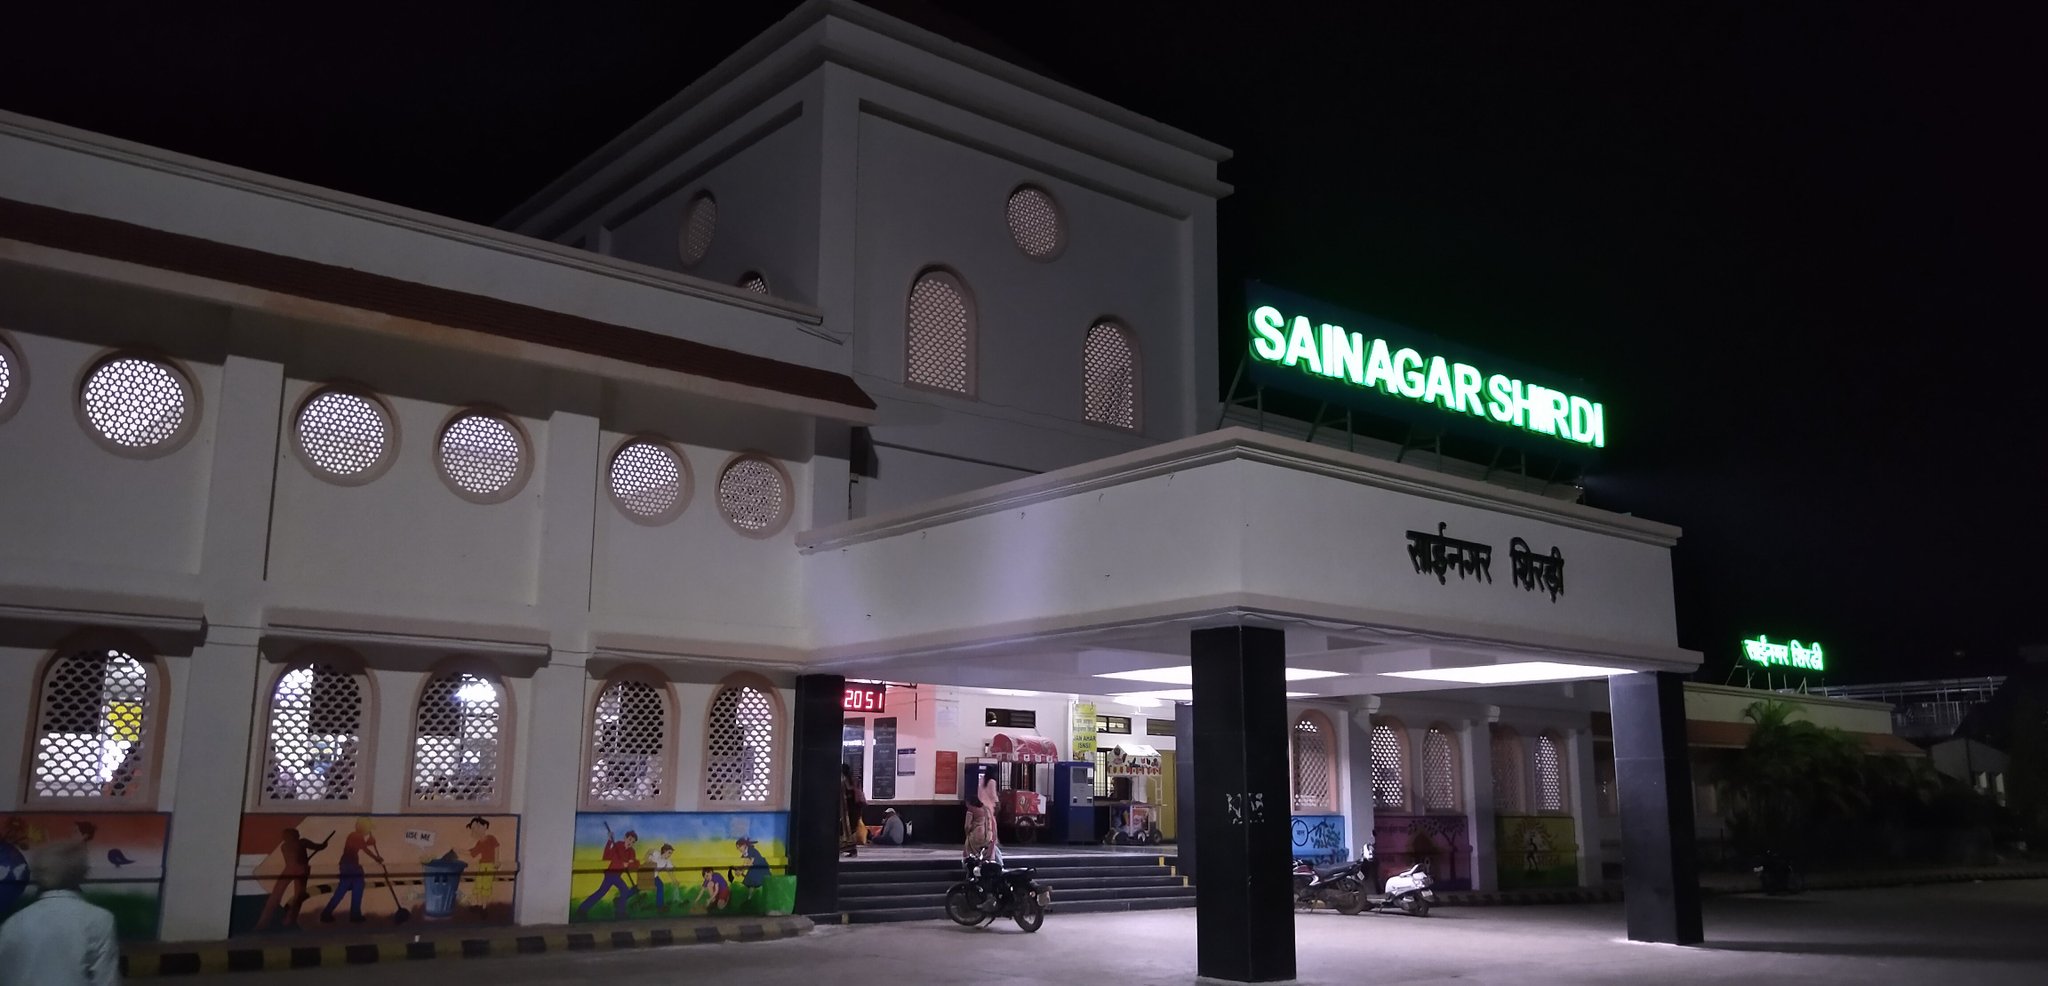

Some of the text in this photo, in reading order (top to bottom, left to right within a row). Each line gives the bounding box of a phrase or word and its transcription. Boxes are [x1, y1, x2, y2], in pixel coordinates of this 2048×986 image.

[1249, 305, 1605, 448] SAINAGAR SHIRDI
[1405, 521, 1492, 586] साईनगर
